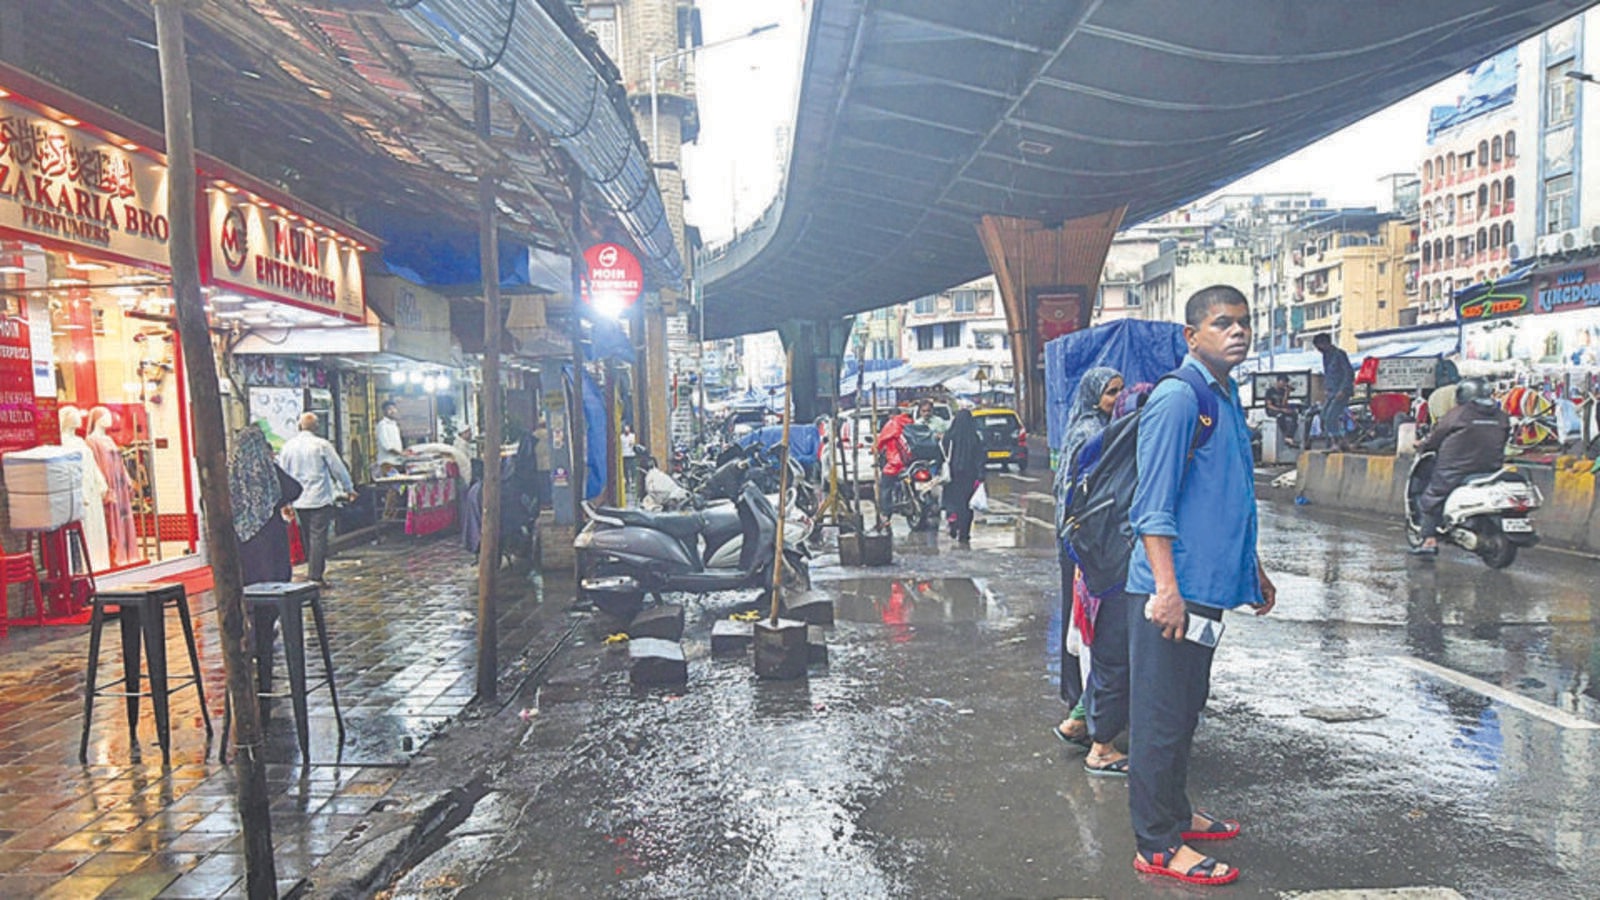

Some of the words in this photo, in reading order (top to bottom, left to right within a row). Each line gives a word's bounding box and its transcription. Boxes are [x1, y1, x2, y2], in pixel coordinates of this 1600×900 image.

[0, 164, 119, 230] ZAKARIA
[273, 220, 319, 270] MOIN
[255, 254, 336, 303] ENTERPRISES
[592, 268, 626, 279] MOIN
